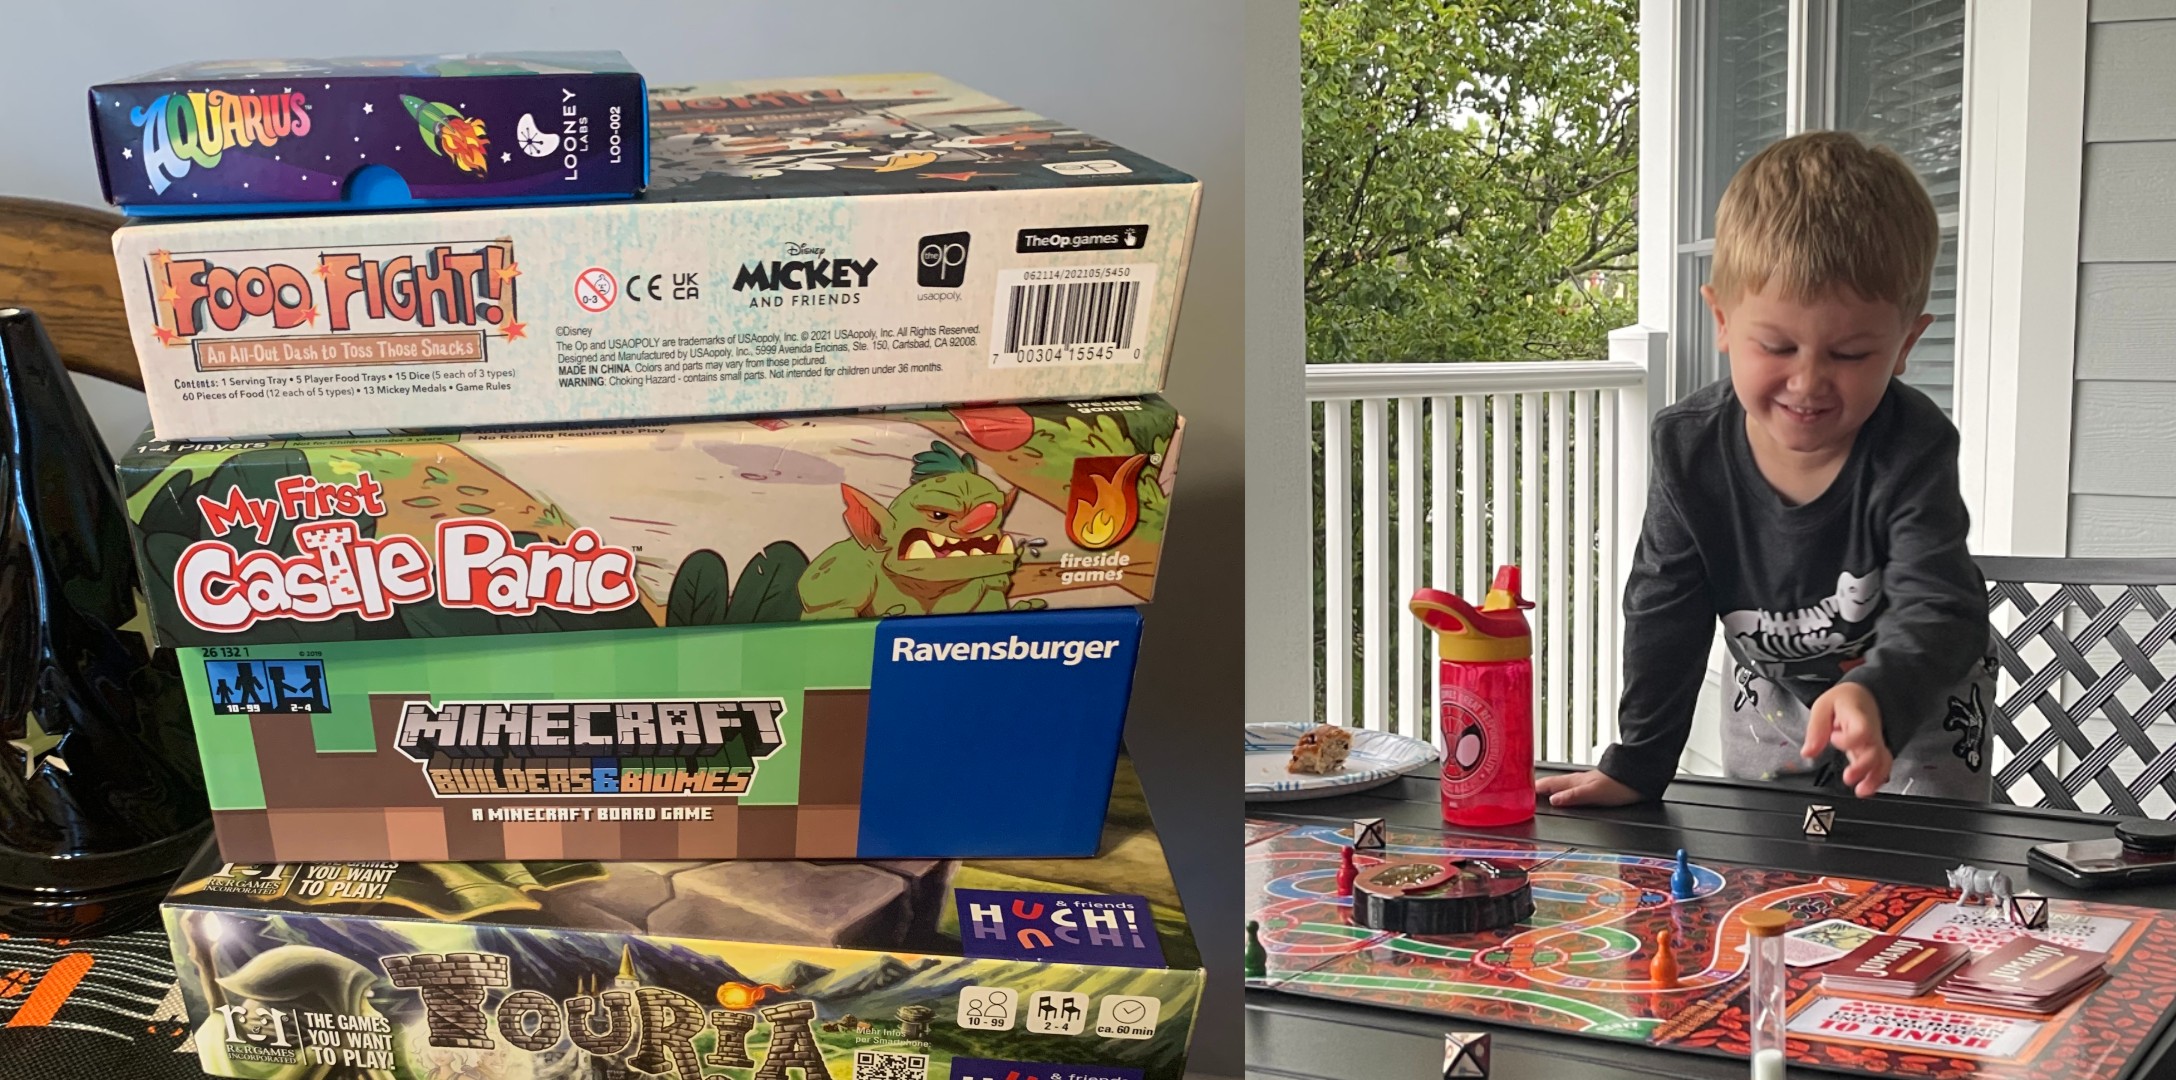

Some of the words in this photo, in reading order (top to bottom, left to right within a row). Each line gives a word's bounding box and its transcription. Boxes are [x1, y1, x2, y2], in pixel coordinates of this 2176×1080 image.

[130, 89, 311, 196] AQUARIUS
[562, 87, 578, 181] LOONEY
[579, 116, 589, 152] LABS
[609, 106, 621, 164] LOO-002
[1025, 233, 1119, 248] TheOp.games
[673, 272, 698, 285] UK
[732, 257, 878, 292] MICKEY
[1023, 267, 1130, 281] 062114/202105/5450
[166, 258, 313, 337] FOOD
[320, 245, 504, 333] FIGHT!
[626, 274, 662, 302] CE
[673, 287, 699, 300] CA
[582, 295, 598, 304] 0-3
[750, 296, 783, 308] AND
[792, 293, 861, 307] FRIENDS
[556, 341, 573, 351] The
[575, 340, 588, 352] Op
[590, 340, 606, 350] and
[608, 337, 660, 349] USAOPOLY
[678, 335, 725, 347] trademarks
[784, 332, 799, 342] Inc.
[811, 330, 831, 340] 2021
[880, 327, 895, 338] Inc.
[910, 326, 936, 337] Rights
[939, 324, 980, 335] Reserved.
[207, 346, 225, 364] An
[230, 343, 280, 363] All-Out
[283, 343, 318, 361] Dash
[321, 345, 336, 360] to
[341, 342, 373, 359] Toss
[376, 340, 418, 358] Those
[421, 337, 474, 357] Snacks
[558, 353, 598, 365] Designed
[600, 352, 615, 362] and
[618, 350, 675, 361] Manufactured
[755, 345, 777, 356] 5999
[778, 344, 812, 354] Avenida
[815, 342, 850, 353] Encinas,
[852, 341, 868, 351] Ste.
[872, 341, 889, 351] 150,
[892, 339, 931, 350] Carlsbad,
[949, 337, 977, 347] 92008.
[1016, 348, 1062, 363] 00304
[1069, 347, 1113, 361] 15545
[558, 365, 586, 375] MADE
[600, 364, 633, 374] CHINA.
[635, 362, 662, 373] Colors
[664, 361, 680, 371] and
[682, 361, 703, 372] parts
[705, 361, 723, 372] may
[725, 360, 743, 371] vary
[745, 358, 764, 368] from
[766, 357, 789, 367] those
[791, 355, 827, 367] pictured.
[558, 377, 606, 388] WARNING:
[608, 375, 644, 387] Choking
[645, 374, 676, 385] Hazard
[684, 372, 718, 383] contains
[720, 371, 742, 381] small
[743, 370, 767, 382] parts.
[769, 369, 784, 379] Not
[786, 368, 822, 378] intended
[837, 365, 869, 376] children
[872, 364, 896, 374] under
[910, 362, 943, 373] months.
[174, 378, 219, 390] Contents:
[229, 376, 265, 388] Serving
[267, 376, 287, 387] Tray
[304, 374, 333, 385] Player
[335, 373, 359, 383] Food
[361, 373, 386, 383] Trays
[409, 371, 430, 380] Dice
[443, 370, 465, 380] each
[487, 368, 516, 379] types)
[182, 392, 194, 401] 60
[196, 391, 227, 400] Pieces
[240, 389, 264, 399] Food
[266, 388, 280, 399] (12
[282, 388, 304, 398] each
[306, 387, 316, 397] of
[325, 386, 355, 398] types)
[363, 386, 375, 395] 13
[376, 385, 410, 396] Mickey
[412, 384, 447, 394] Medals
[455, 383, 484, 392] Game
[486, 382, 511, 391] Rules
[1077, 405, 1143, 414] games
[500, 432, 554, 441] Reading
[558, 429, 617, 439] Required
[638, 427, 666, 435] Play
[137, 444, 171, 454] 1-4
[177, 442, 266, 452] Players
[197, 484, 279, 545] My
[274, 470, 387, 521] First
[1059, 551, 1131, 569] fireside
[176, 520, 435, 632] Castle
[436, 517, 639, 616] Panic
[1061, 568, 1123, 585] games
[202, 648, 218, 657] 26
[220, 647, 241, 657] 132
[892, 635, 1119, 665] Ravensburger
[399, 701, 785, 756] MINECRAFT
[429, 767, 592, 794] BUILDERS
[593, 767, 619, 793] &
[620, 767, 752, 793] BIOMES
[472, 808, 484, 821] A
[488, 807, 594, 822] MINECRAFT
[597, 807, 656, 821] BOARD
[661, 806, 714, 820] GAME
[306, 866, 342, 880] YOU
[344, 868, 396, 883] WANT
[203, 885, 277, 895] INCORPORATED
[298, 879, 325, 896] TO
[328, 882, 388, 899] PLAY!
[970, 899, 1138, 930] HUCH!
[1055, 900, 1067, 908] &
[1073, 901, 1135, 909] friends
[1855, 939, 1924, 978] JUMANJI
[1989, 944, 2065, 983] JUMANJI
[304, 1012, 336, 1030] THE
[338, 1014, 391, 1033] GAMES
[856, 1027, 884, 1037] Mehr
[886, 1028, 906, 1038] Infos
[1132, 1026, 1154, 1037] min
[307, 1029, 340, 1047] YOU
[346, 1033, 393, 1050] WANT
[227, 1053, 296, 1064] INCORPORATED
[311, 1046, 337, 1066] TO
[343, 1049, 396, 1070] PLAY!
